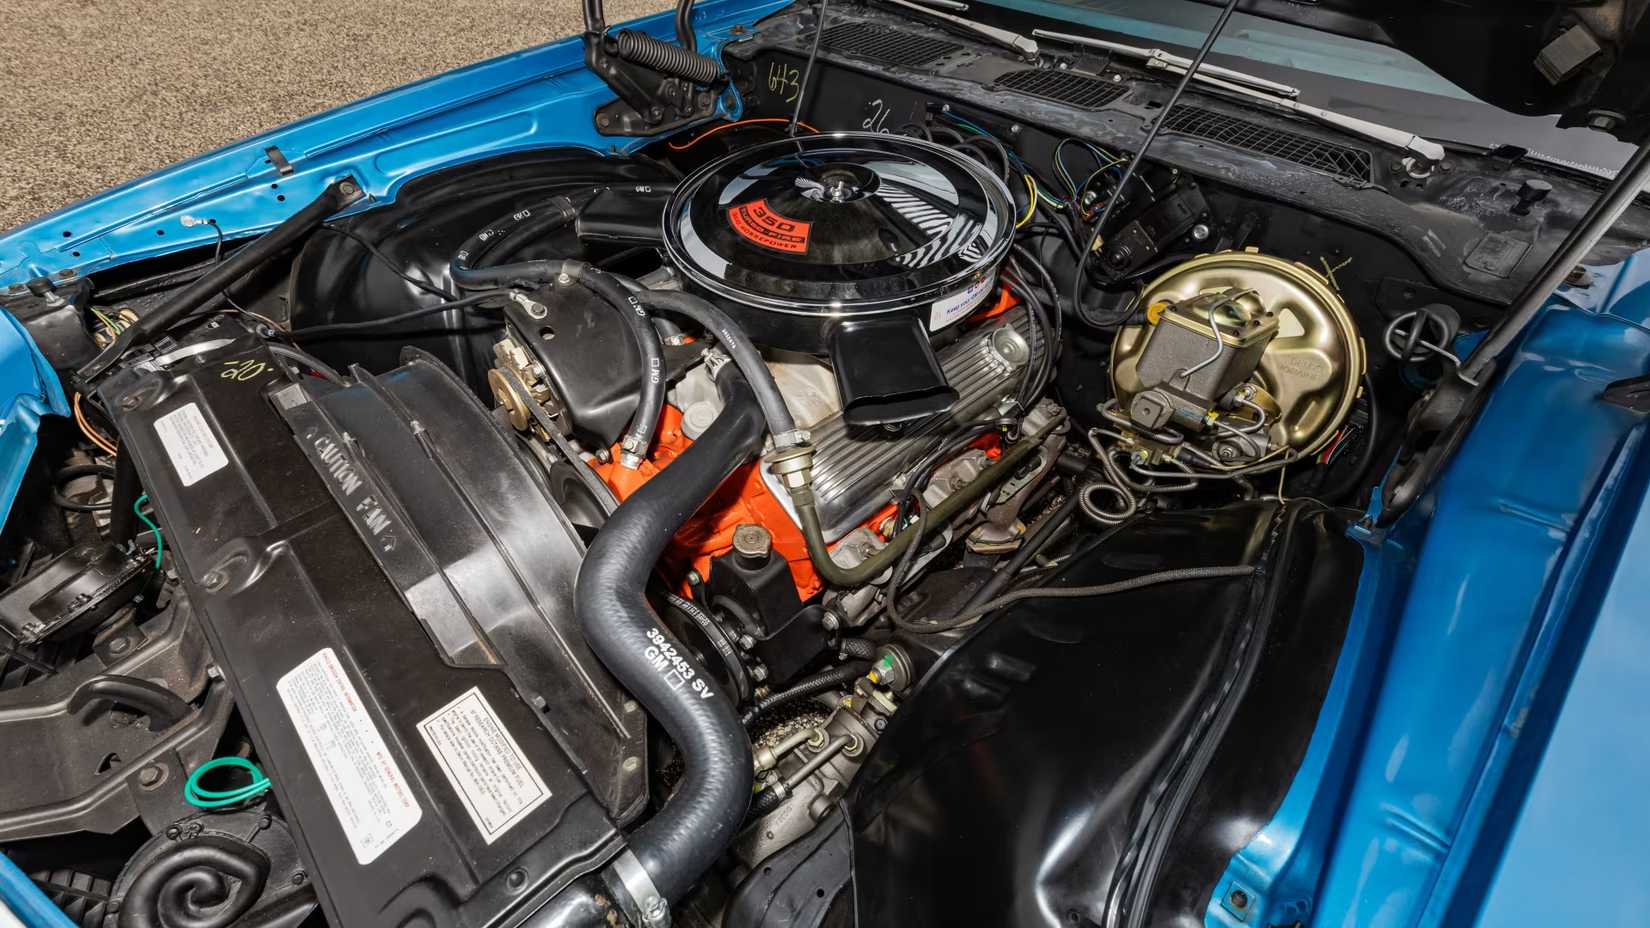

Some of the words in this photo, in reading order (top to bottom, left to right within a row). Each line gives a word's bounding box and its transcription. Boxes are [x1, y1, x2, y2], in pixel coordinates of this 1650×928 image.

[753, 207, 796, 232] 350
[314, 434, 363, 496] CAUTION
[356, 496, 392, 535] FAN
[644, 646, 669, 672] GM
[646, 627, 695, 680] 3942453
[691, 678, 715, 699] SV
